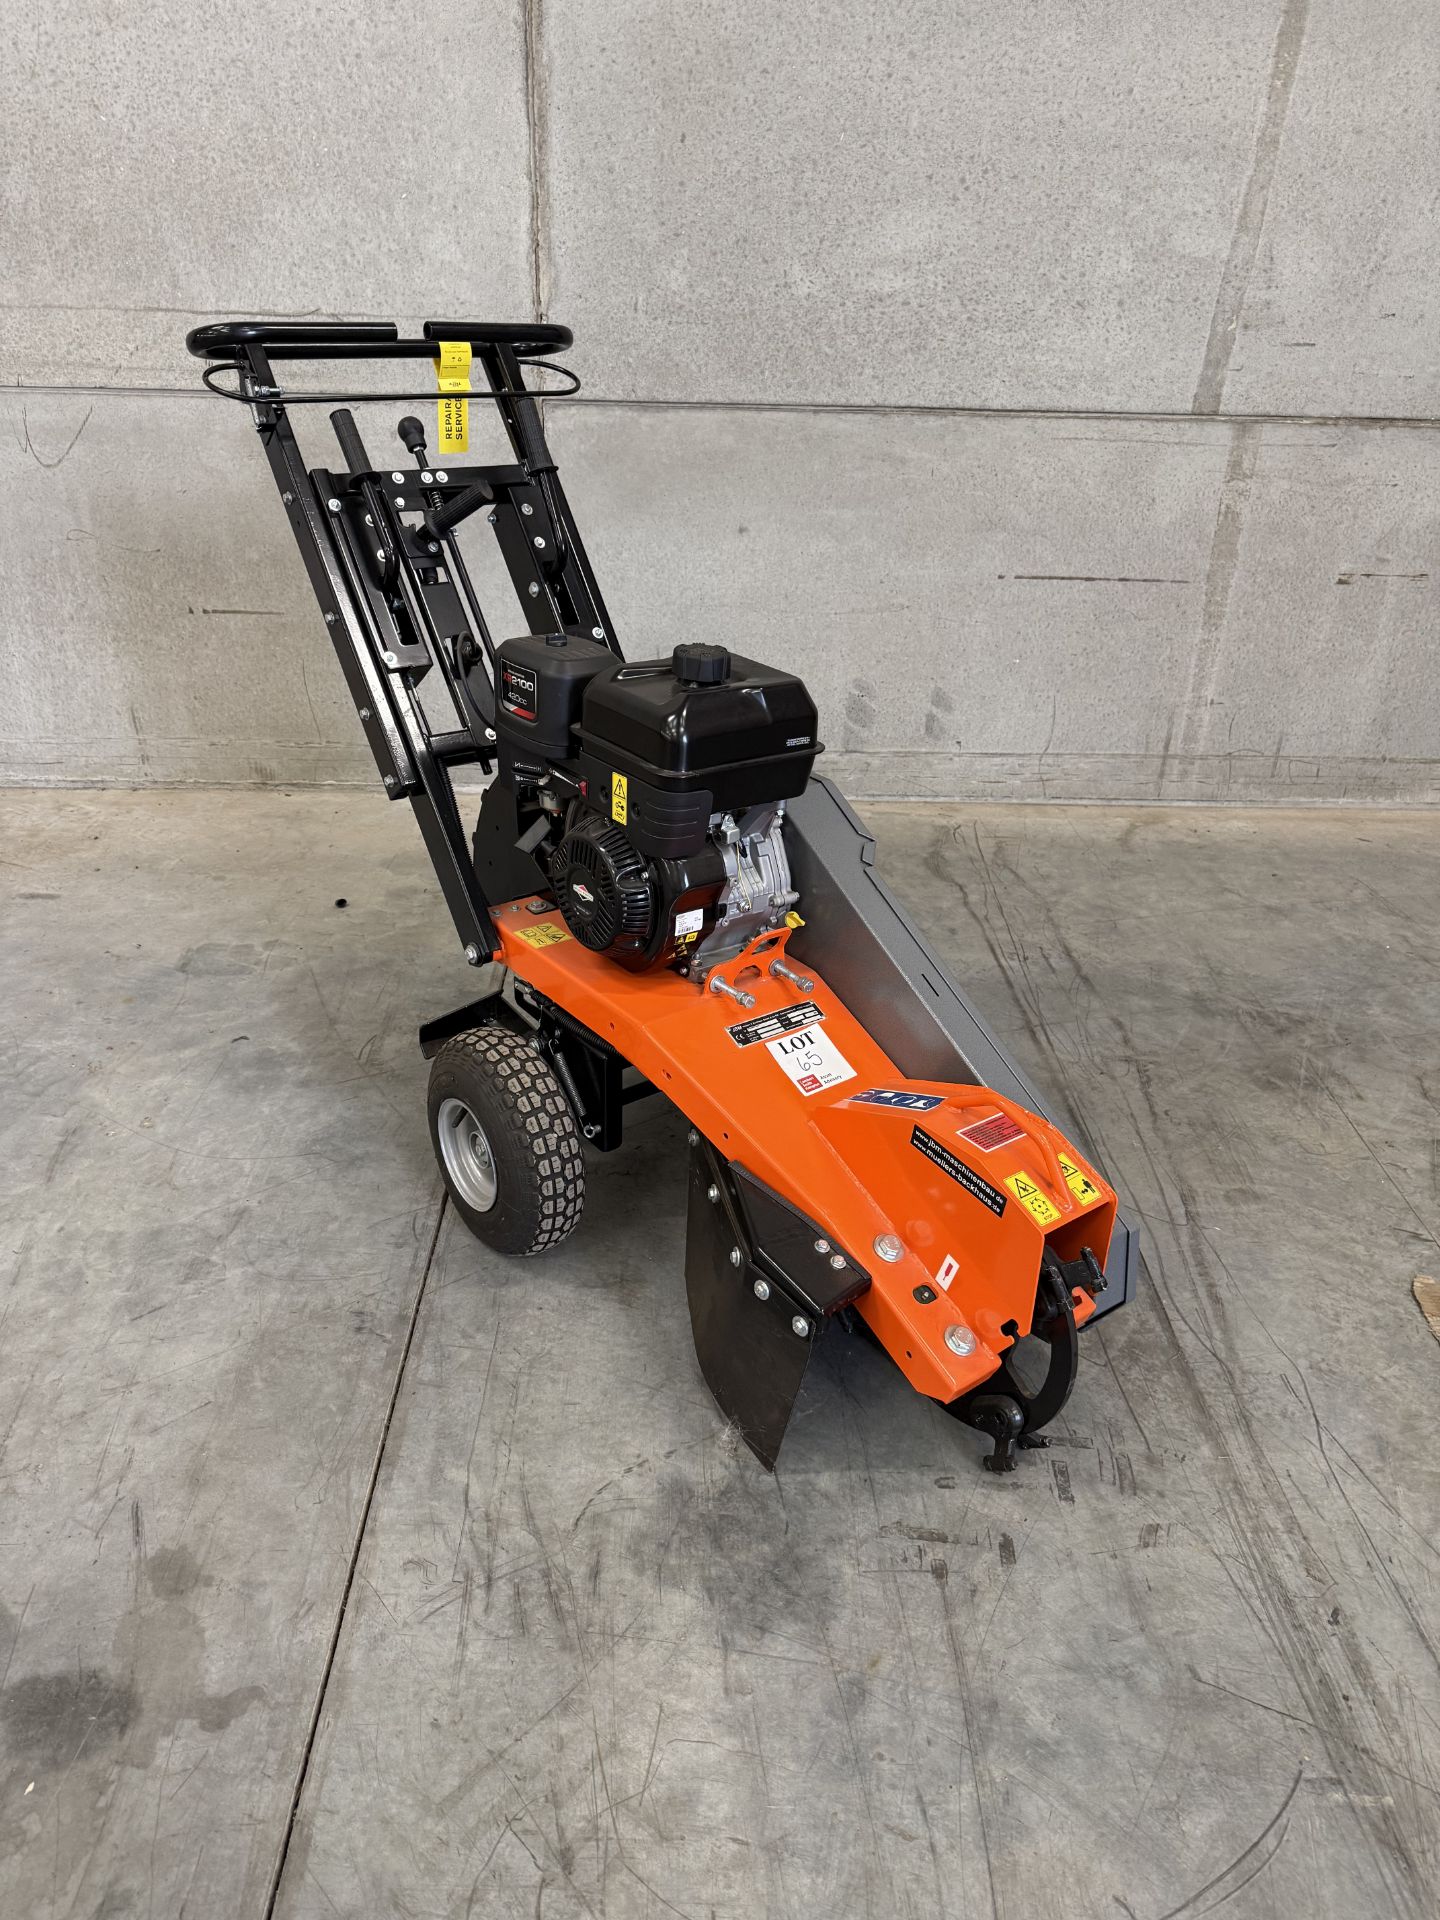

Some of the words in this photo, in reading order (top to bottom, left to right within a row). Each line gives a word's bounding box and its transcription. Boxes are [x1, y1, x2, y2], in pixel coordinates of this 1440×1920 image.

[777, 1031, 815, 1055] LOT
[796, 1050, 823, 1071] 65
[915, 1129, 1004, 1204] www.jbm-maschinenbaude
